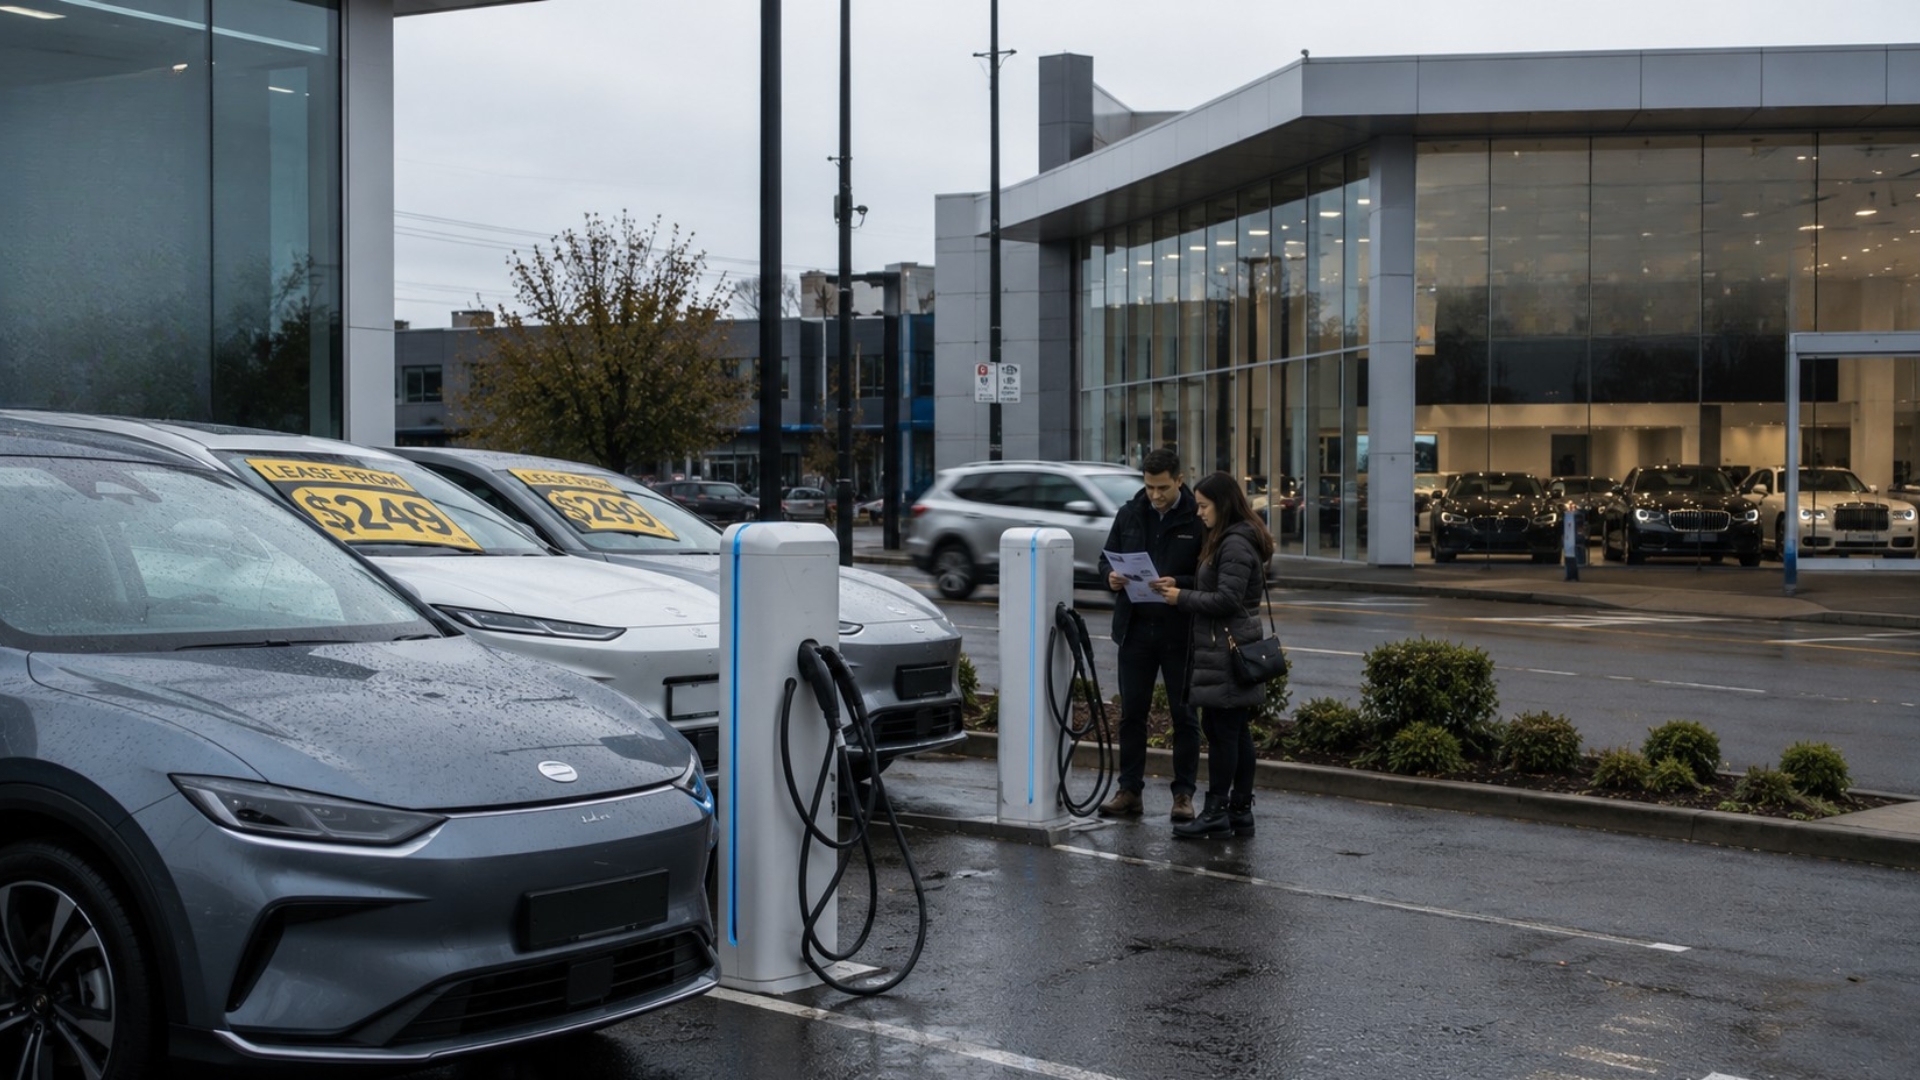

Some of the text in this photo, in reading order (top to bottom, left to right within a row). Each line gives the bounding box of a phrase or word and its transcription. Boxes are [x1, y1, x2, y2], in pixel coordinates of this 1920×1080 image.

[263, 464, 405, 488] LEASE FROM
[304, 489, 453, 536] $249
[554, 493, 657, 528] $299
